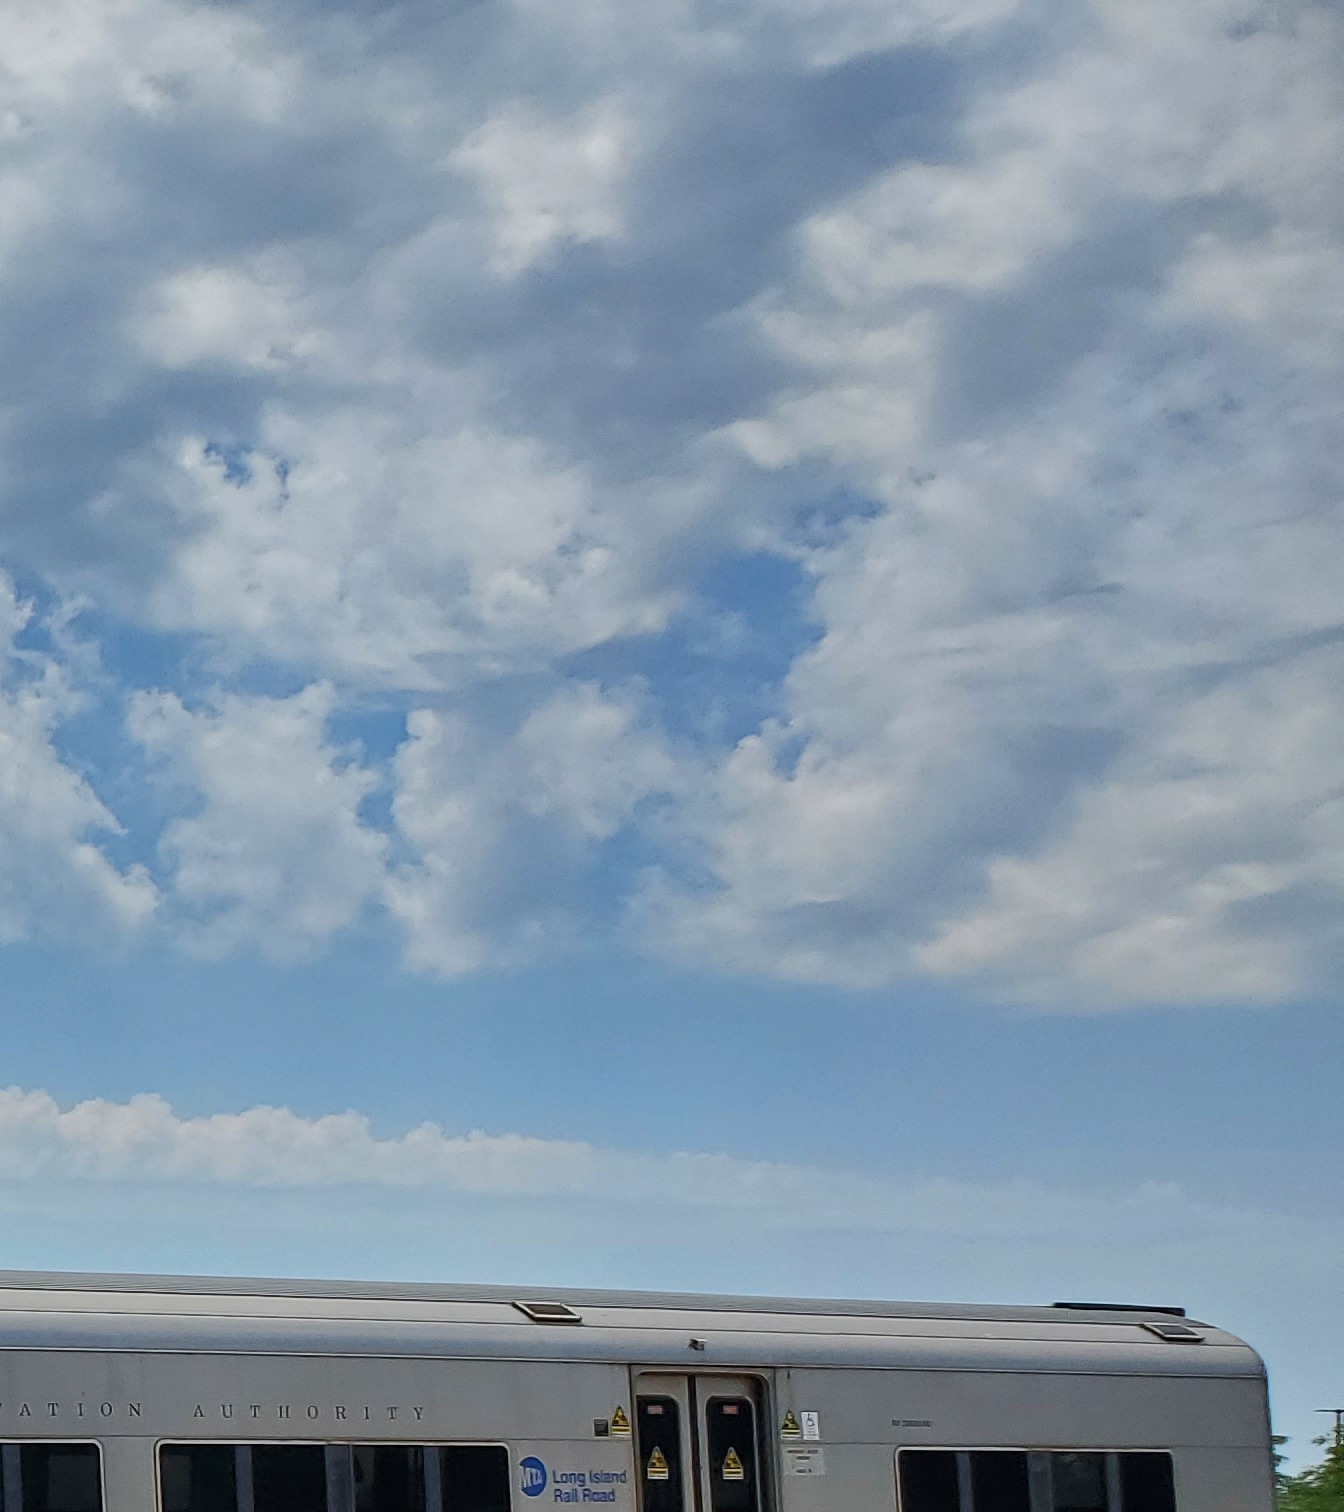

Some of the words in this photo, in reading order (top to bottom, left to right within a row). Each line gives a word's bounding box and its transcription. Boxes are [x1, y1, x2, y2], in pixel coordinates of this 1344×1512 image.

[193, 1404, 424, 1421] AUTHORITY
[552, 1470, 586, 1487] Long
[589, 1470, 627, 1483] Island
[554, 1488, 578, 1502] Rail
[582, 1488, 616, 1502] Road
